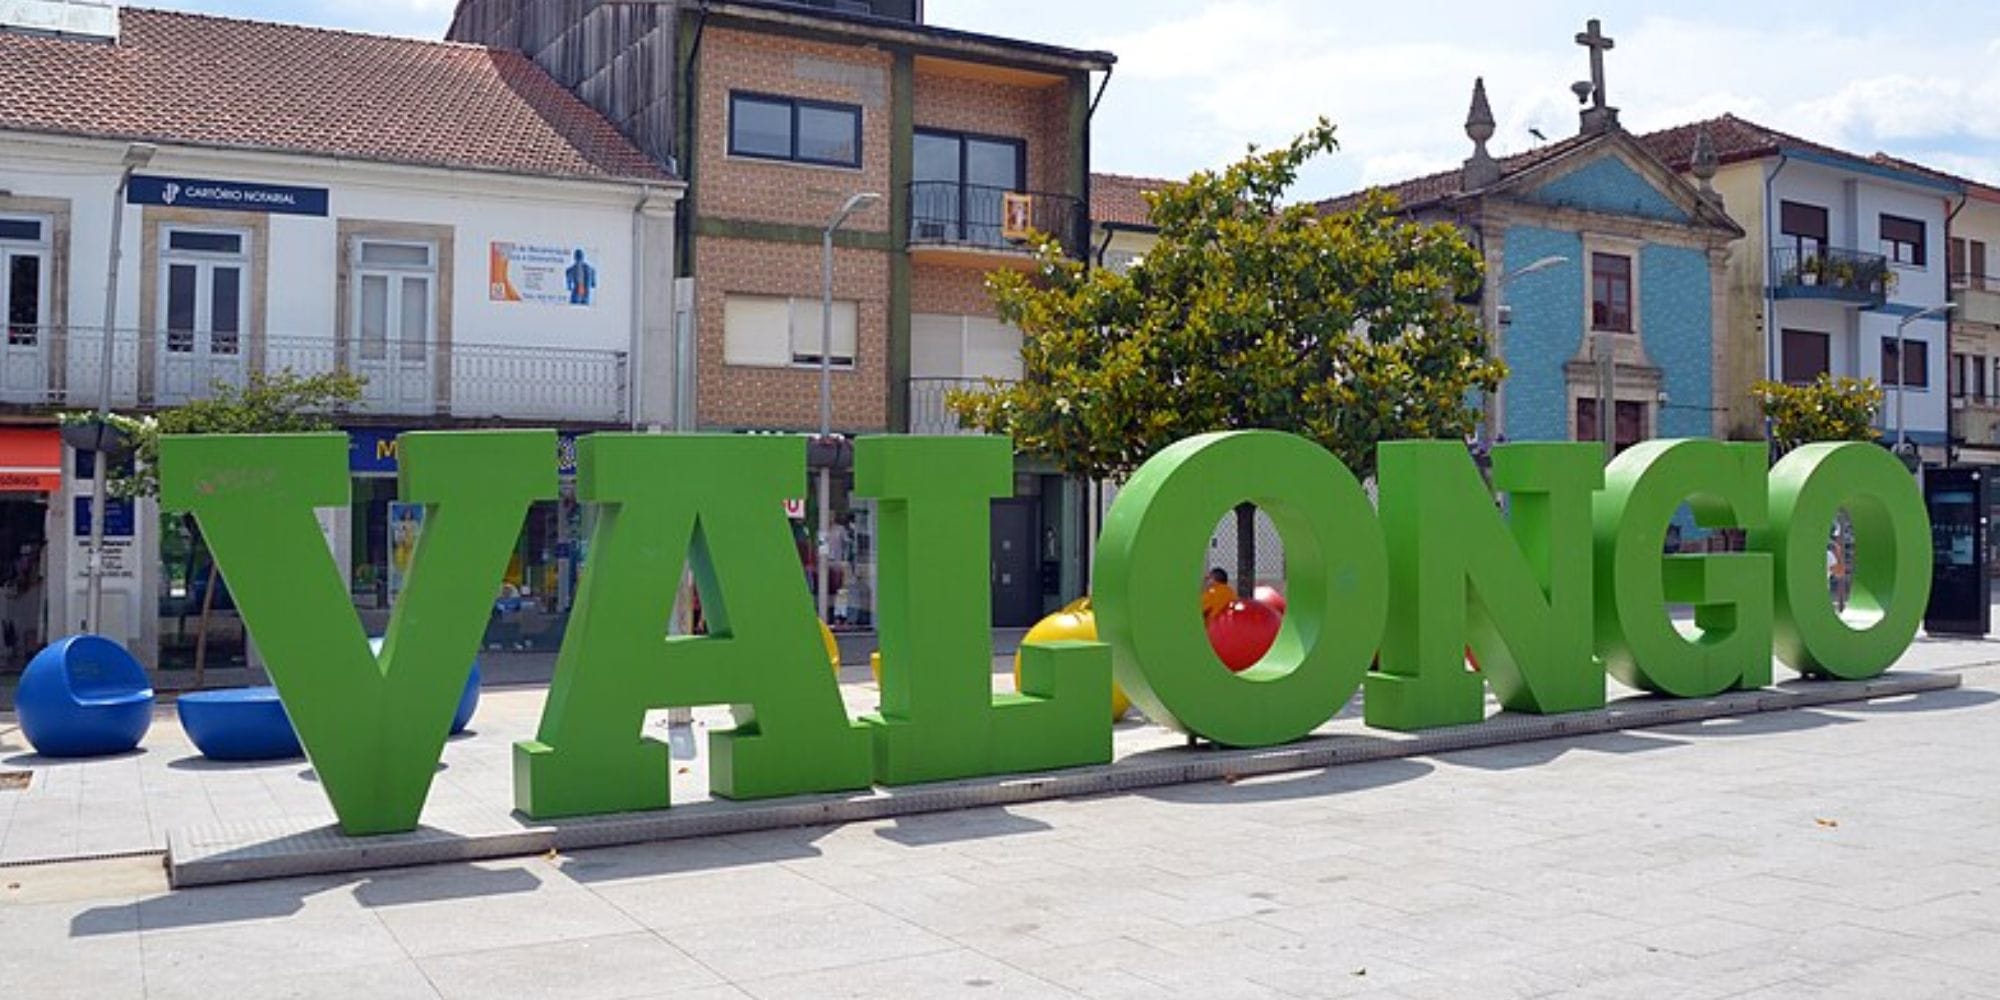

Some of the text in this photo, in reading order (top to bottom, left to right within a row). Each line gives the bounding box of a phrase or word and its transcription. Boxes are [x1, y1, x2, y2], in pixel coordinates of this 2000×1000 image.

[185, 185, 296, 204] CARTÓRIO NOTARIAL
[159, 429, 1931, 836] VALONGO
